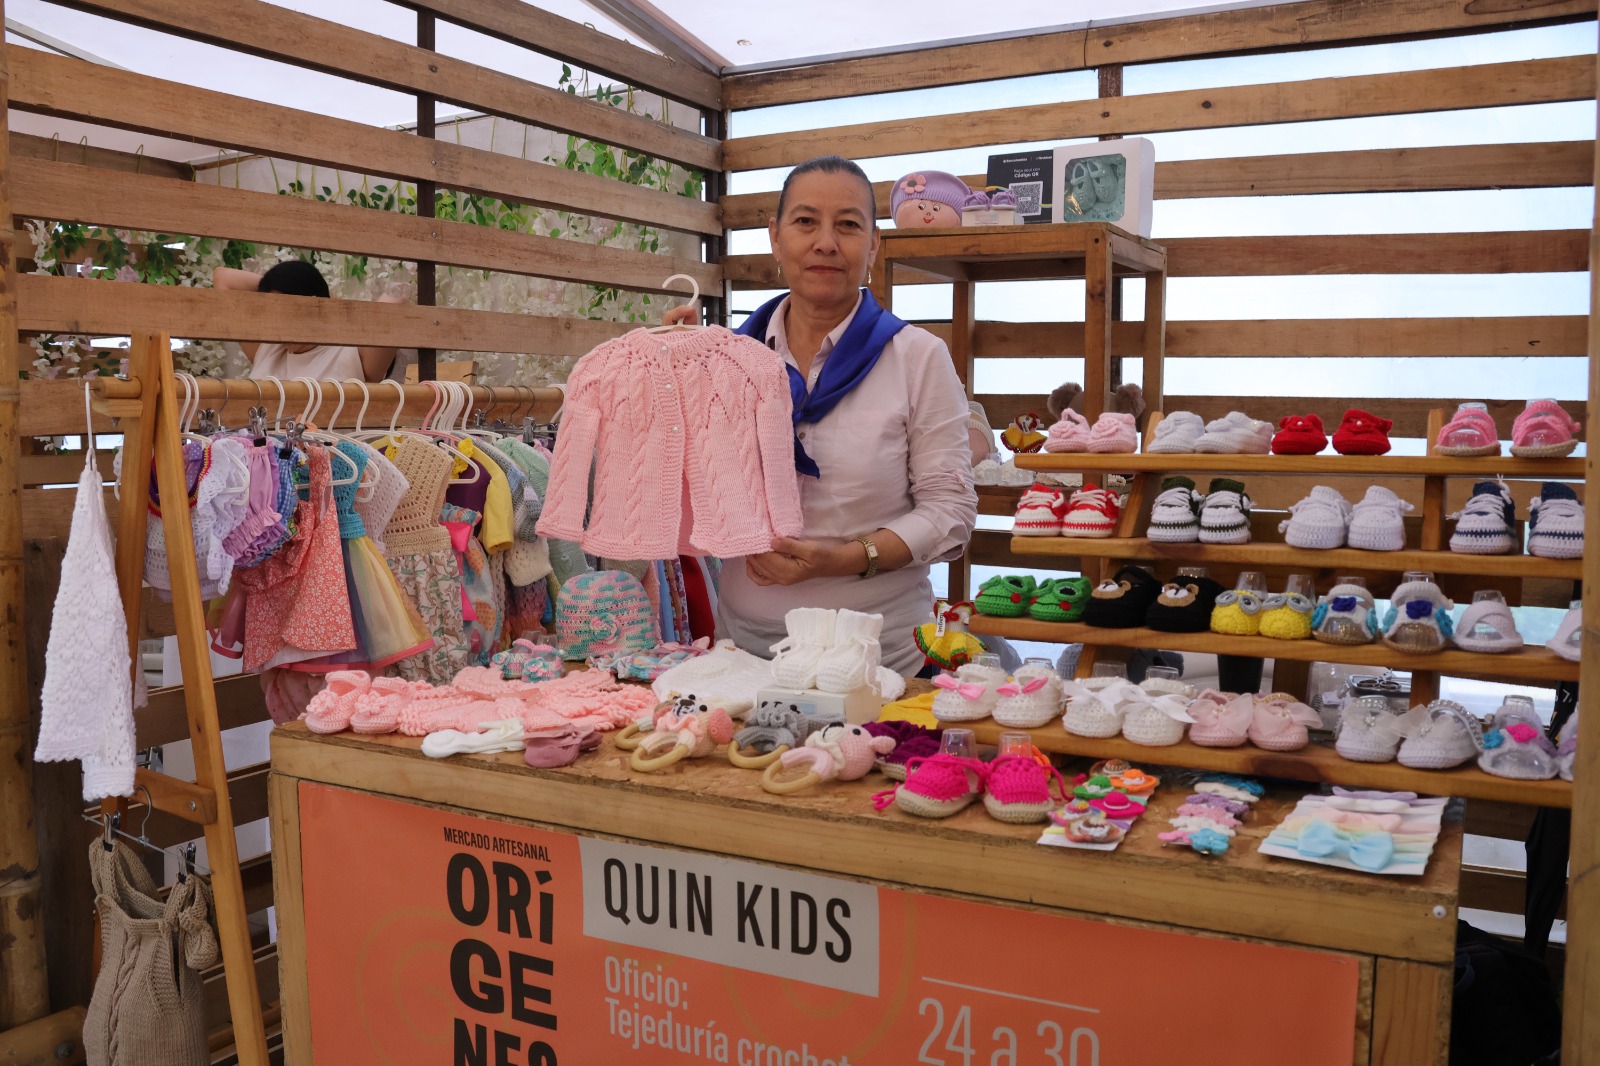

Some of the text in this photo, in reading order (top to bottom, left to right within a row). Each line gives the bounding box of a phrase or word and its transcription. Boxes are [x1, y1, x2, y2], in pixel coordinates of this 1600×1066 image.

[443, 826, 551, 863] MERCADO ARTESANAL
[603, 857, 852, 963] QUIN KIDS
[449, 938, 558, 1031] GE
[604, 955, 689, 1010] Oficio:
[604, 997, 729, 1064] Tejeduría
[918, 997, 976, 1066] 24
[990, 1025, 1018, 1066] a
